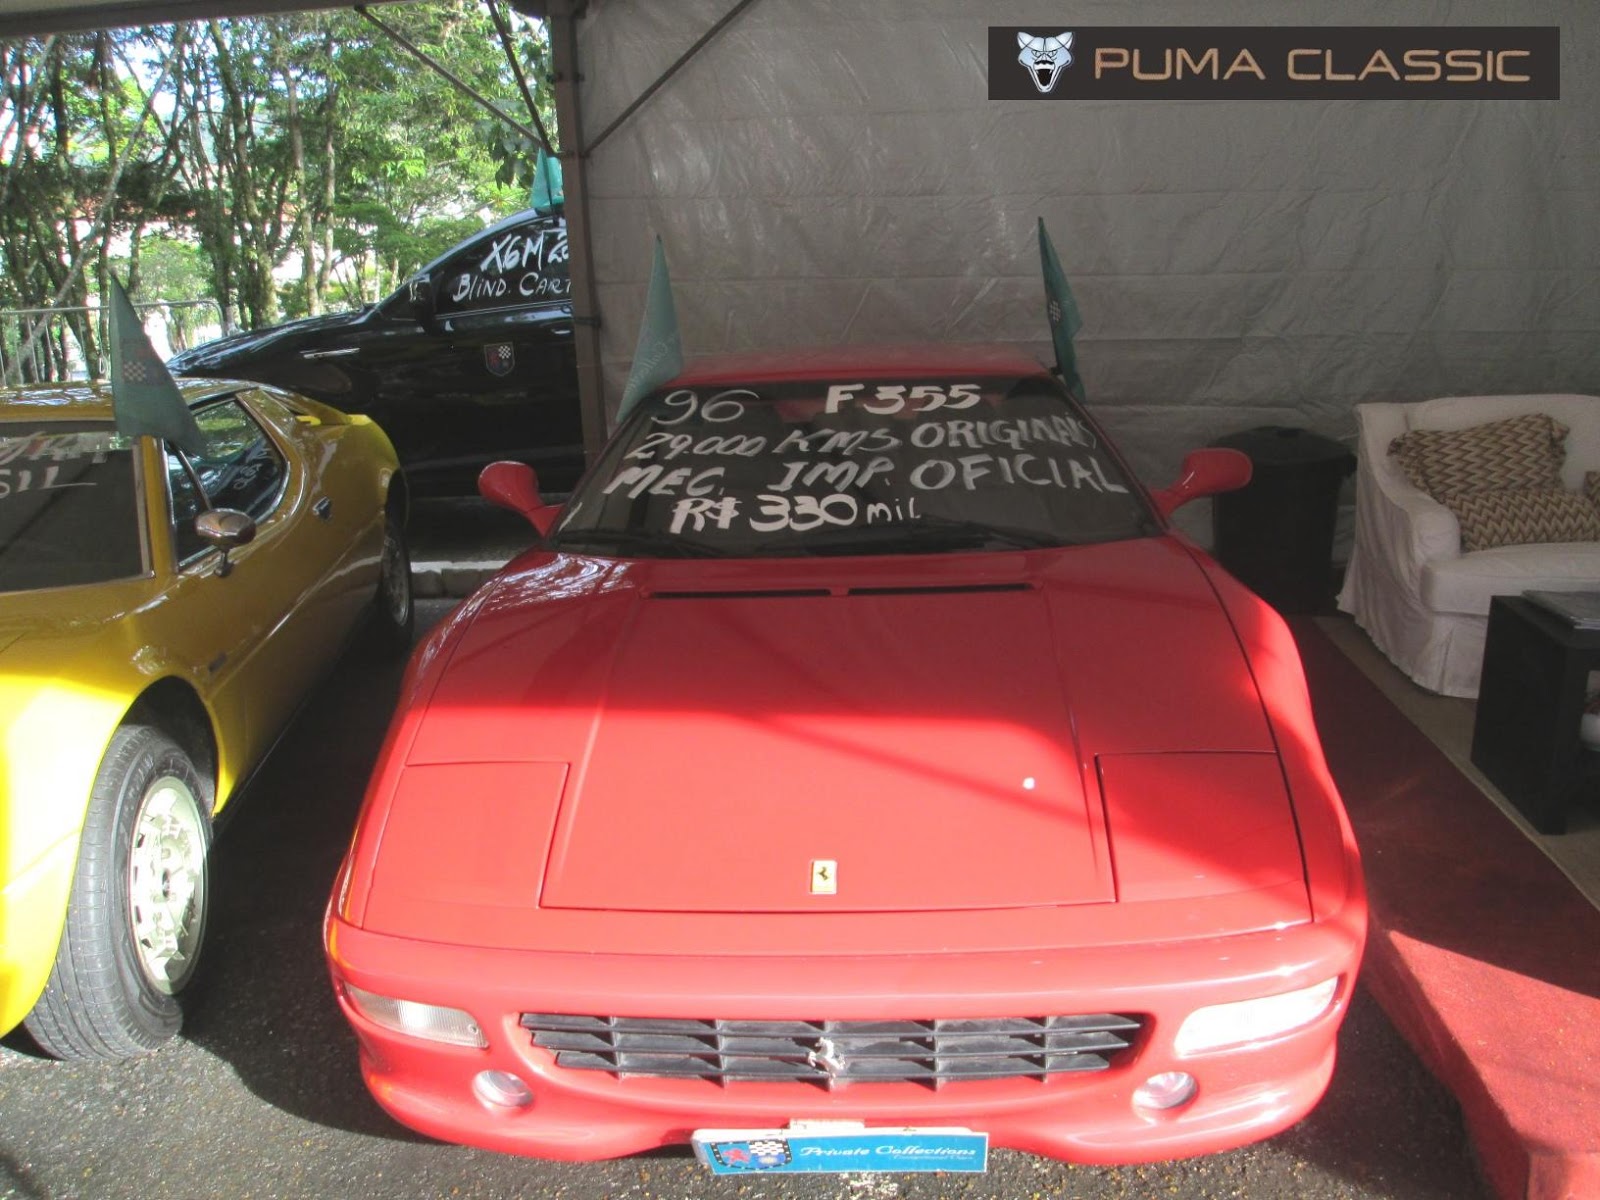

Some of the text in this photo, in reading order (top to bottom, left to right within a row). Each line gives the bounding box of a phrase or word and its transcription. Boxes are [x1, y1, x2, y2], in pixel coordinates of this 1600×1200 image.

[480, 231, 545, 273] X6M
[651, 389, 759, 425] 96
[623, 432, 768, 460] 29.000
[909, 453, 1130, 494] OFICIAL
[750, 493, 858, 532] 330
[799, 1145, 977, 1156] Private Collections
